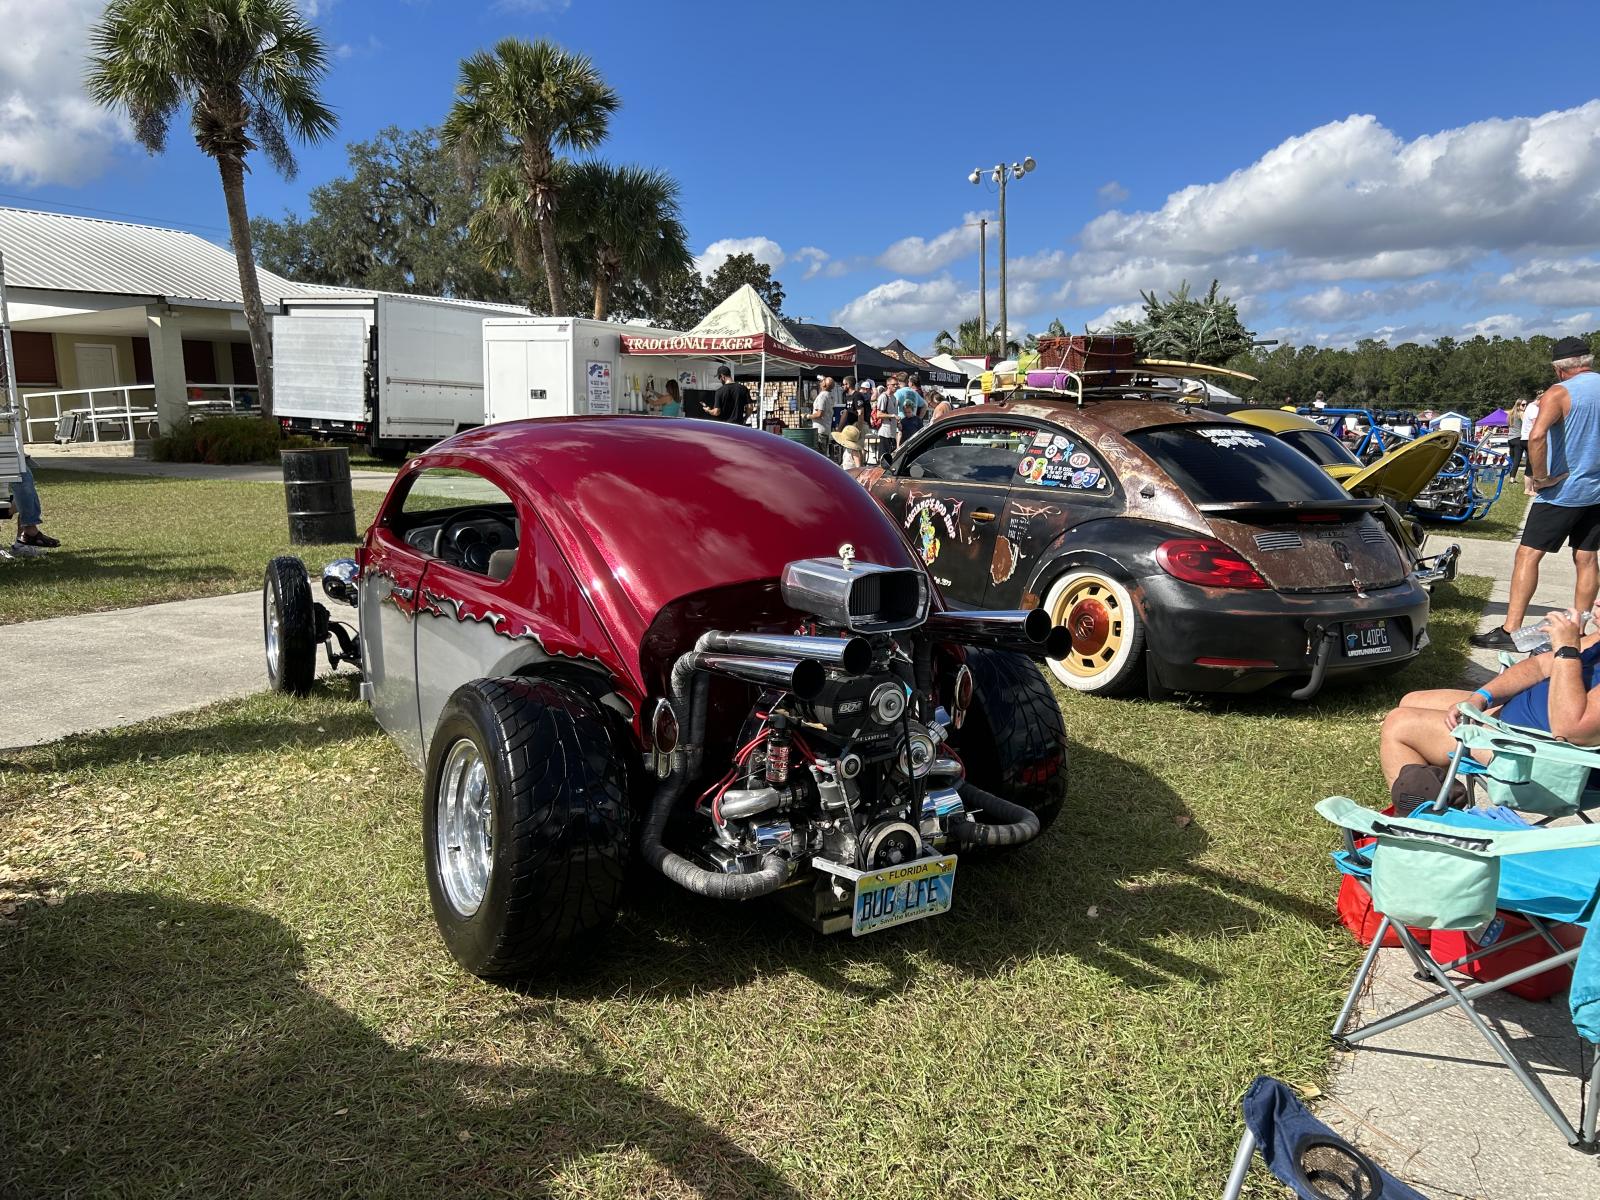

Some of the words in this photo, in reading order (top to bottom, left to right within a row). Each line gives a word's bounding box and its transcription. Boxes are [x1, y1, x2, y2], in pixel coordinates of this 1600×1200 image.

[627, 336, 709, 350] TRADITIONAL
[711, 337, 754, 350] LAGER
[1083, 473, 1096, 483] 57
[935, 500, 947, 516] ROD
[944, 513, 956, 539] SHOP
[888, 864, 929, 880] FLORIDA
[861, 886, 896, 922] BUG
[905, 875, 940, 909] LFE
[880, 915, 894, 924] Save
[894, 912, 904, 921] the
[904, 908, 927, 919] Manatee
